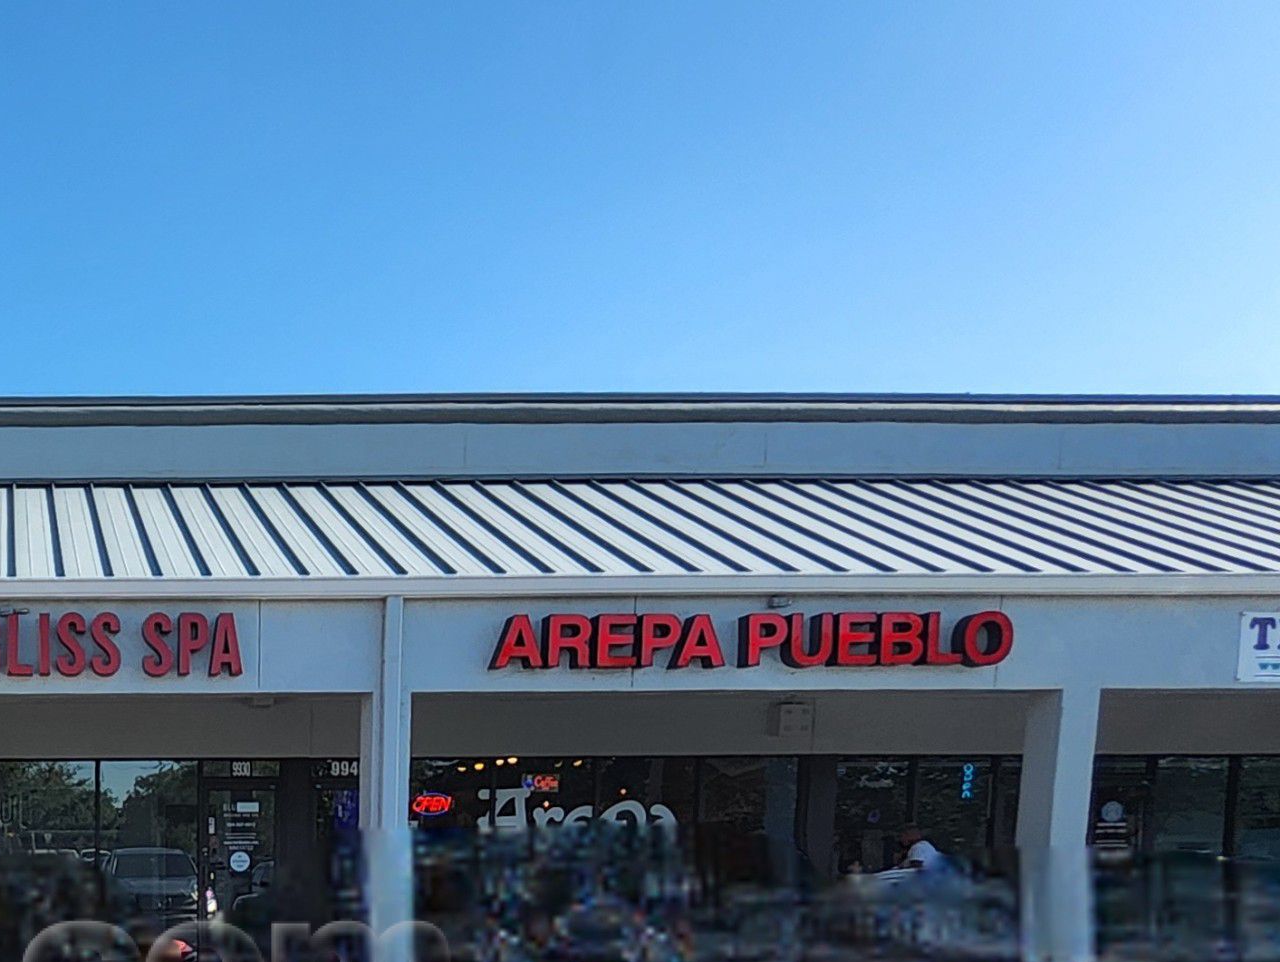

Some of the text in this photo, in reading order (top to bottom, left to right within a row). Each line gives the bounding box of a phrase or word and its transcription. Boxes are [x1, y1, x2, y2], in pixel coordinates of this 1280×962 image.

[141, 612, 243, 677] SPA
[488, 611, 1014, 670] AREPA PUEBLO
[1249, 617, 1280, 650] T
[232, 761, 252, 777] 9930
[412, 796, 452, 812] OPEN
